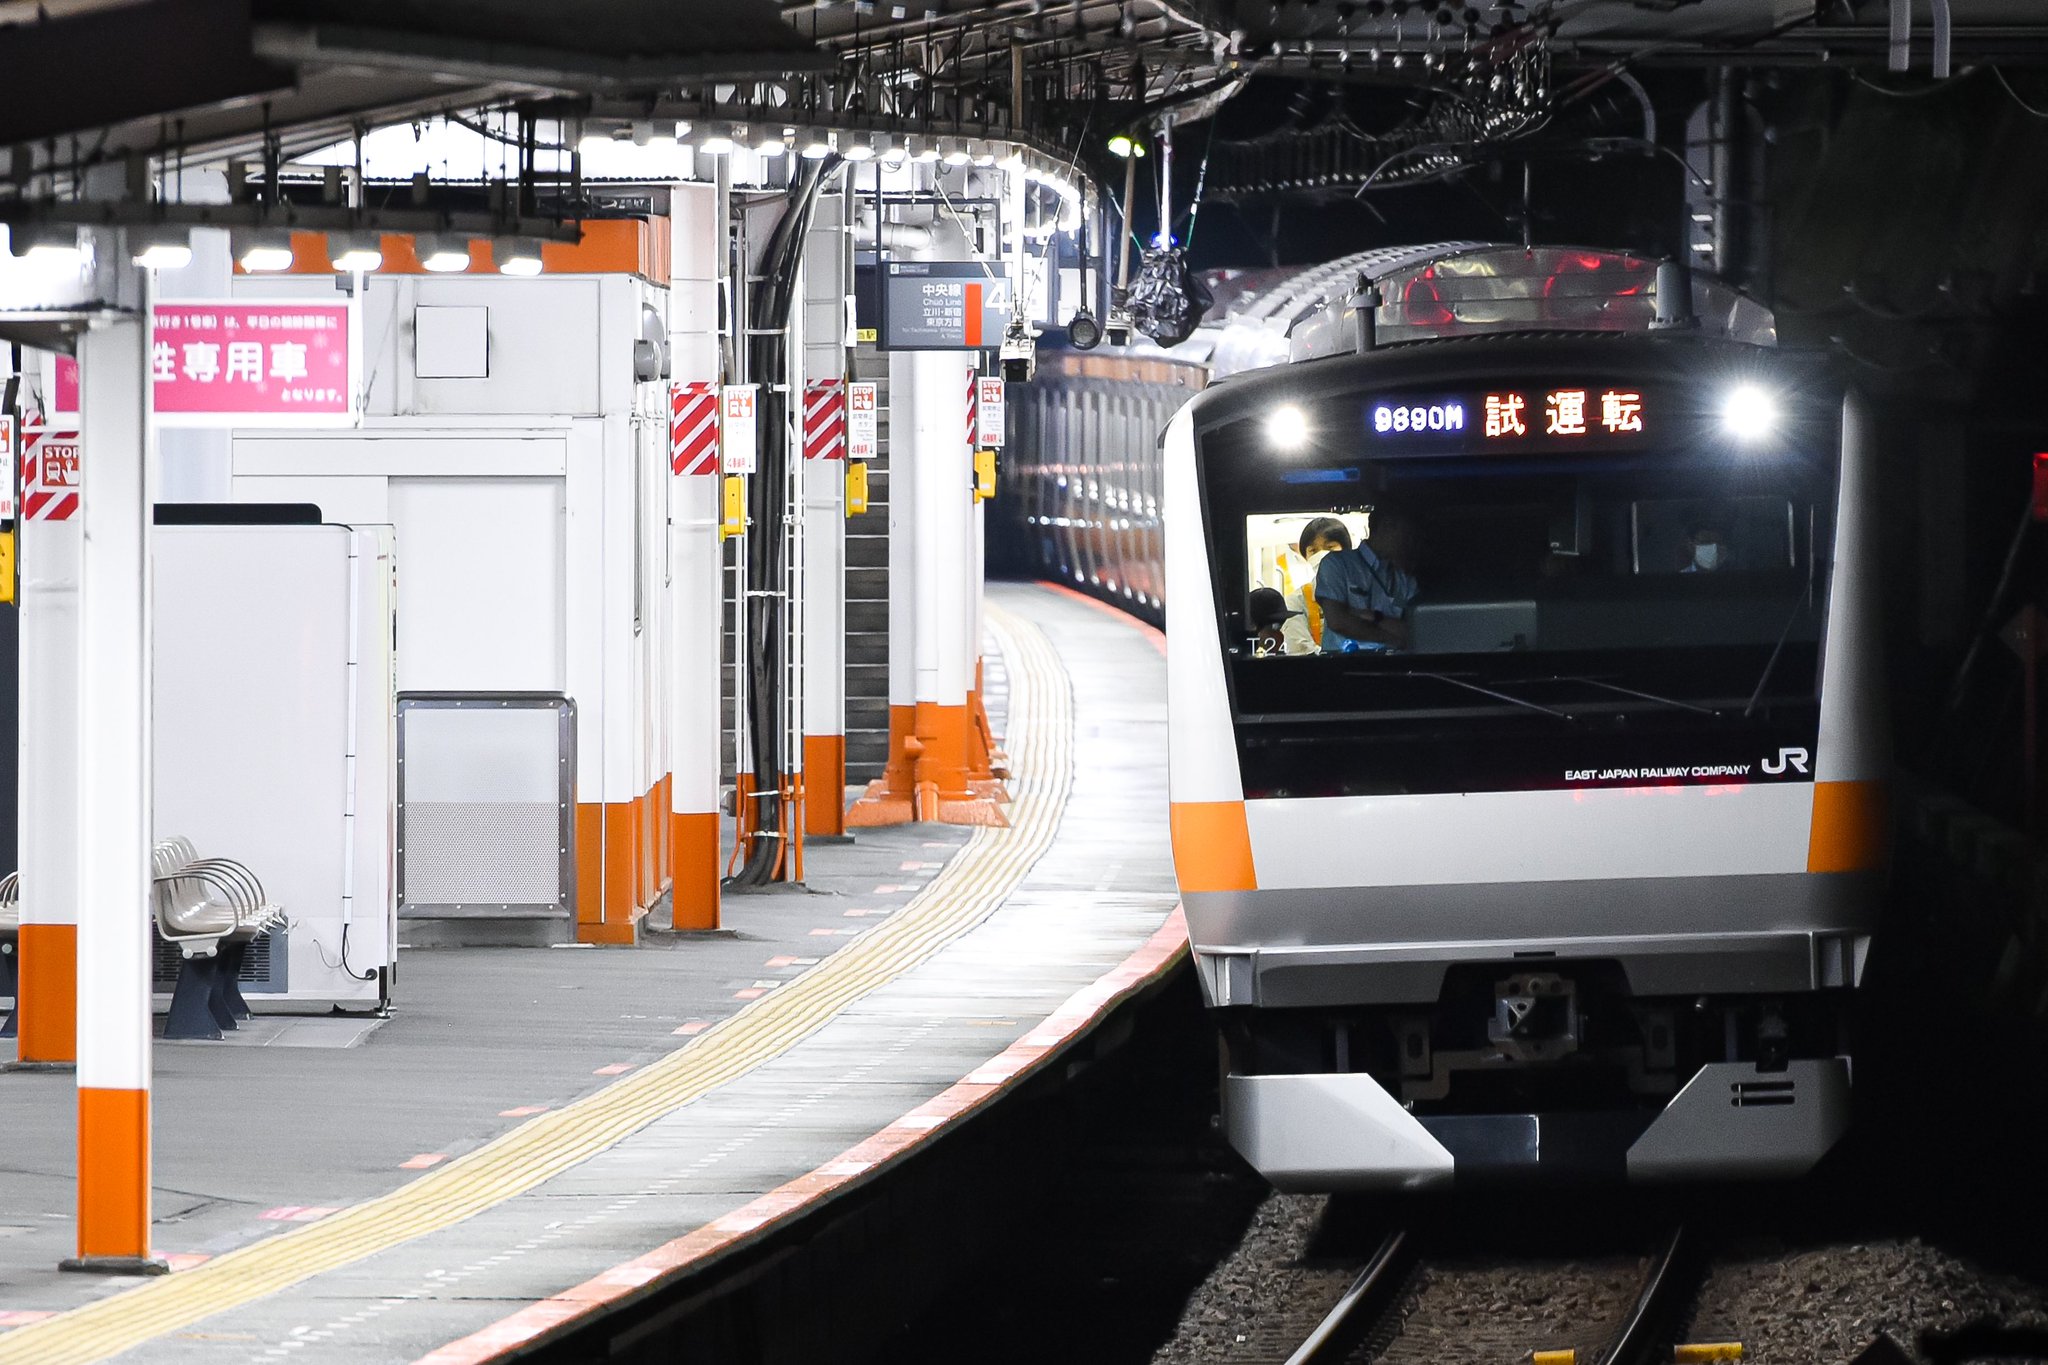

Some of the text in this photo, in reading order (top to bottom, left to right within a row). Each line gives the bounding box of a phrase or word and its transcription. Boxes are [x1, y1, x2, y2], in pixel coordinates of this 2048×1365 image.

[985, 283, 1009, 315] 4
[853, 387, 873, 395] STOP
[1485, 390, 1642, 437] 試運転
[1565, 764, 1750, 780] EAST JAPAN RAILWAY COMPANY
[1761, 747, 1809, 774] JR
